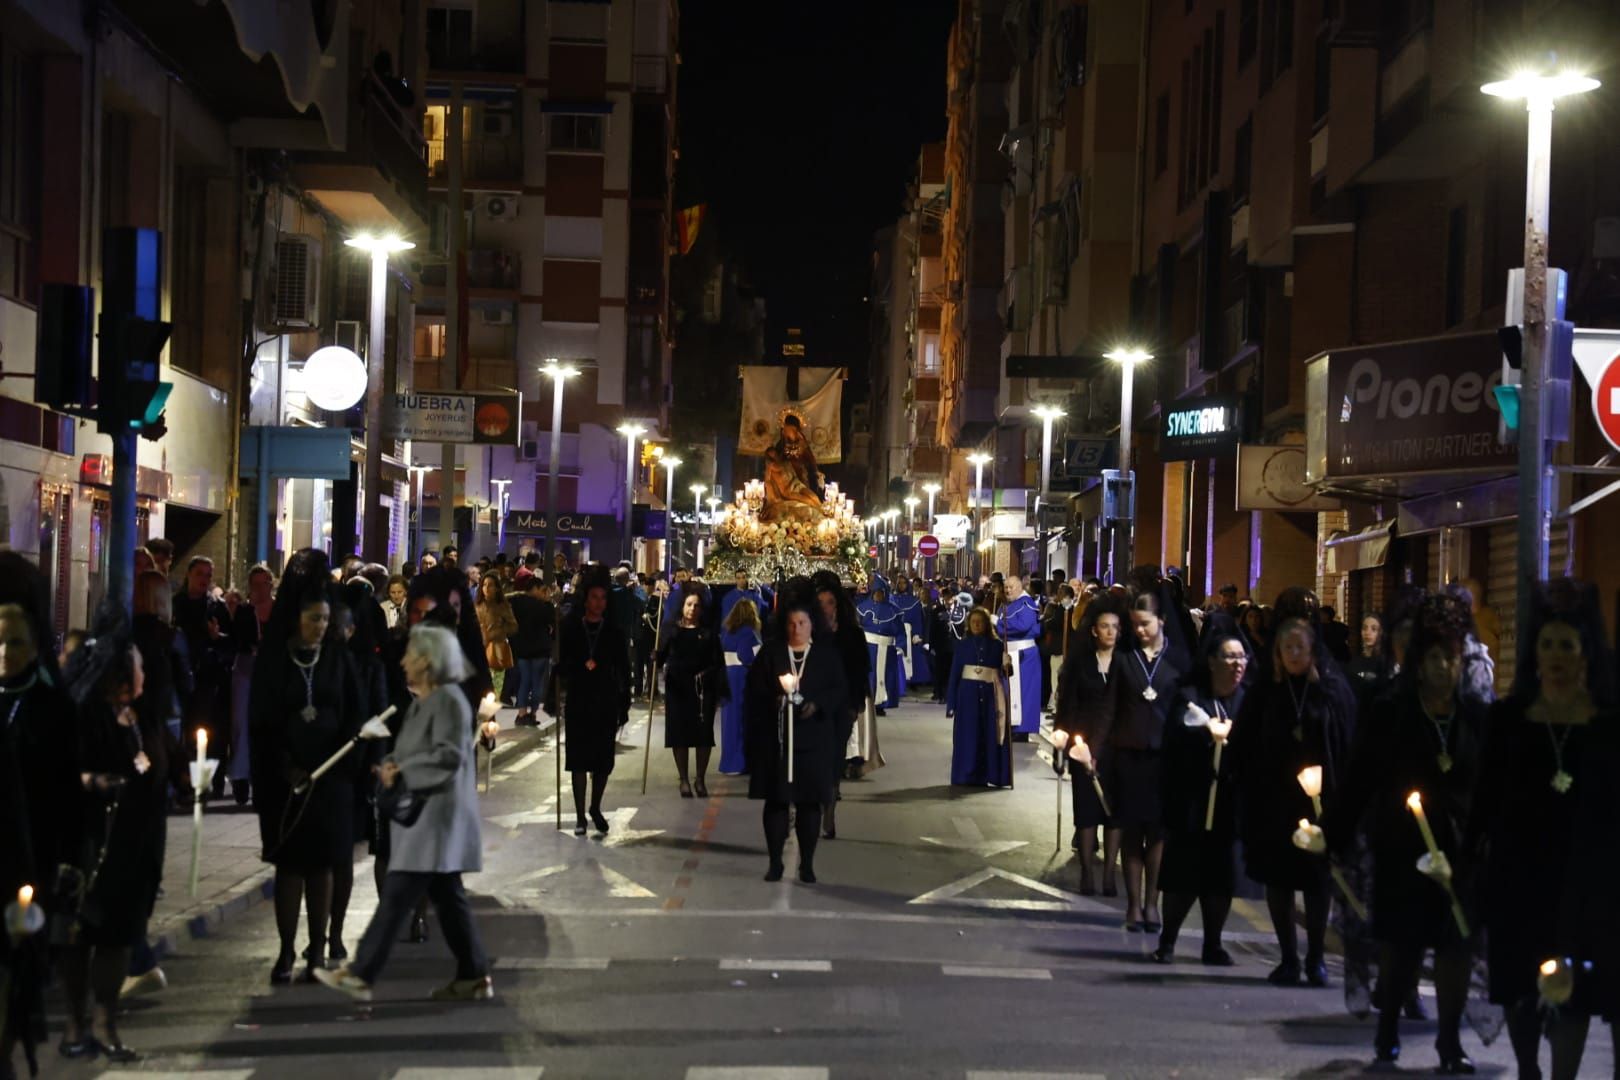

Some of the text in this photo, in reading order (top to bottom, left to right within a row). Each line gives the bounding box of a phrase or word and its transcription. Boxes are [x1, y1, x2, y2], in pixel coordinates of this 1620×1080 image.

[1343, 357, 1502, 419] Pionee
[395, 396, 465, 411] HUEBRA
[425, 413, 466, 422] JOYEROS
[1424, 432, 1492, 459] PARTNER
